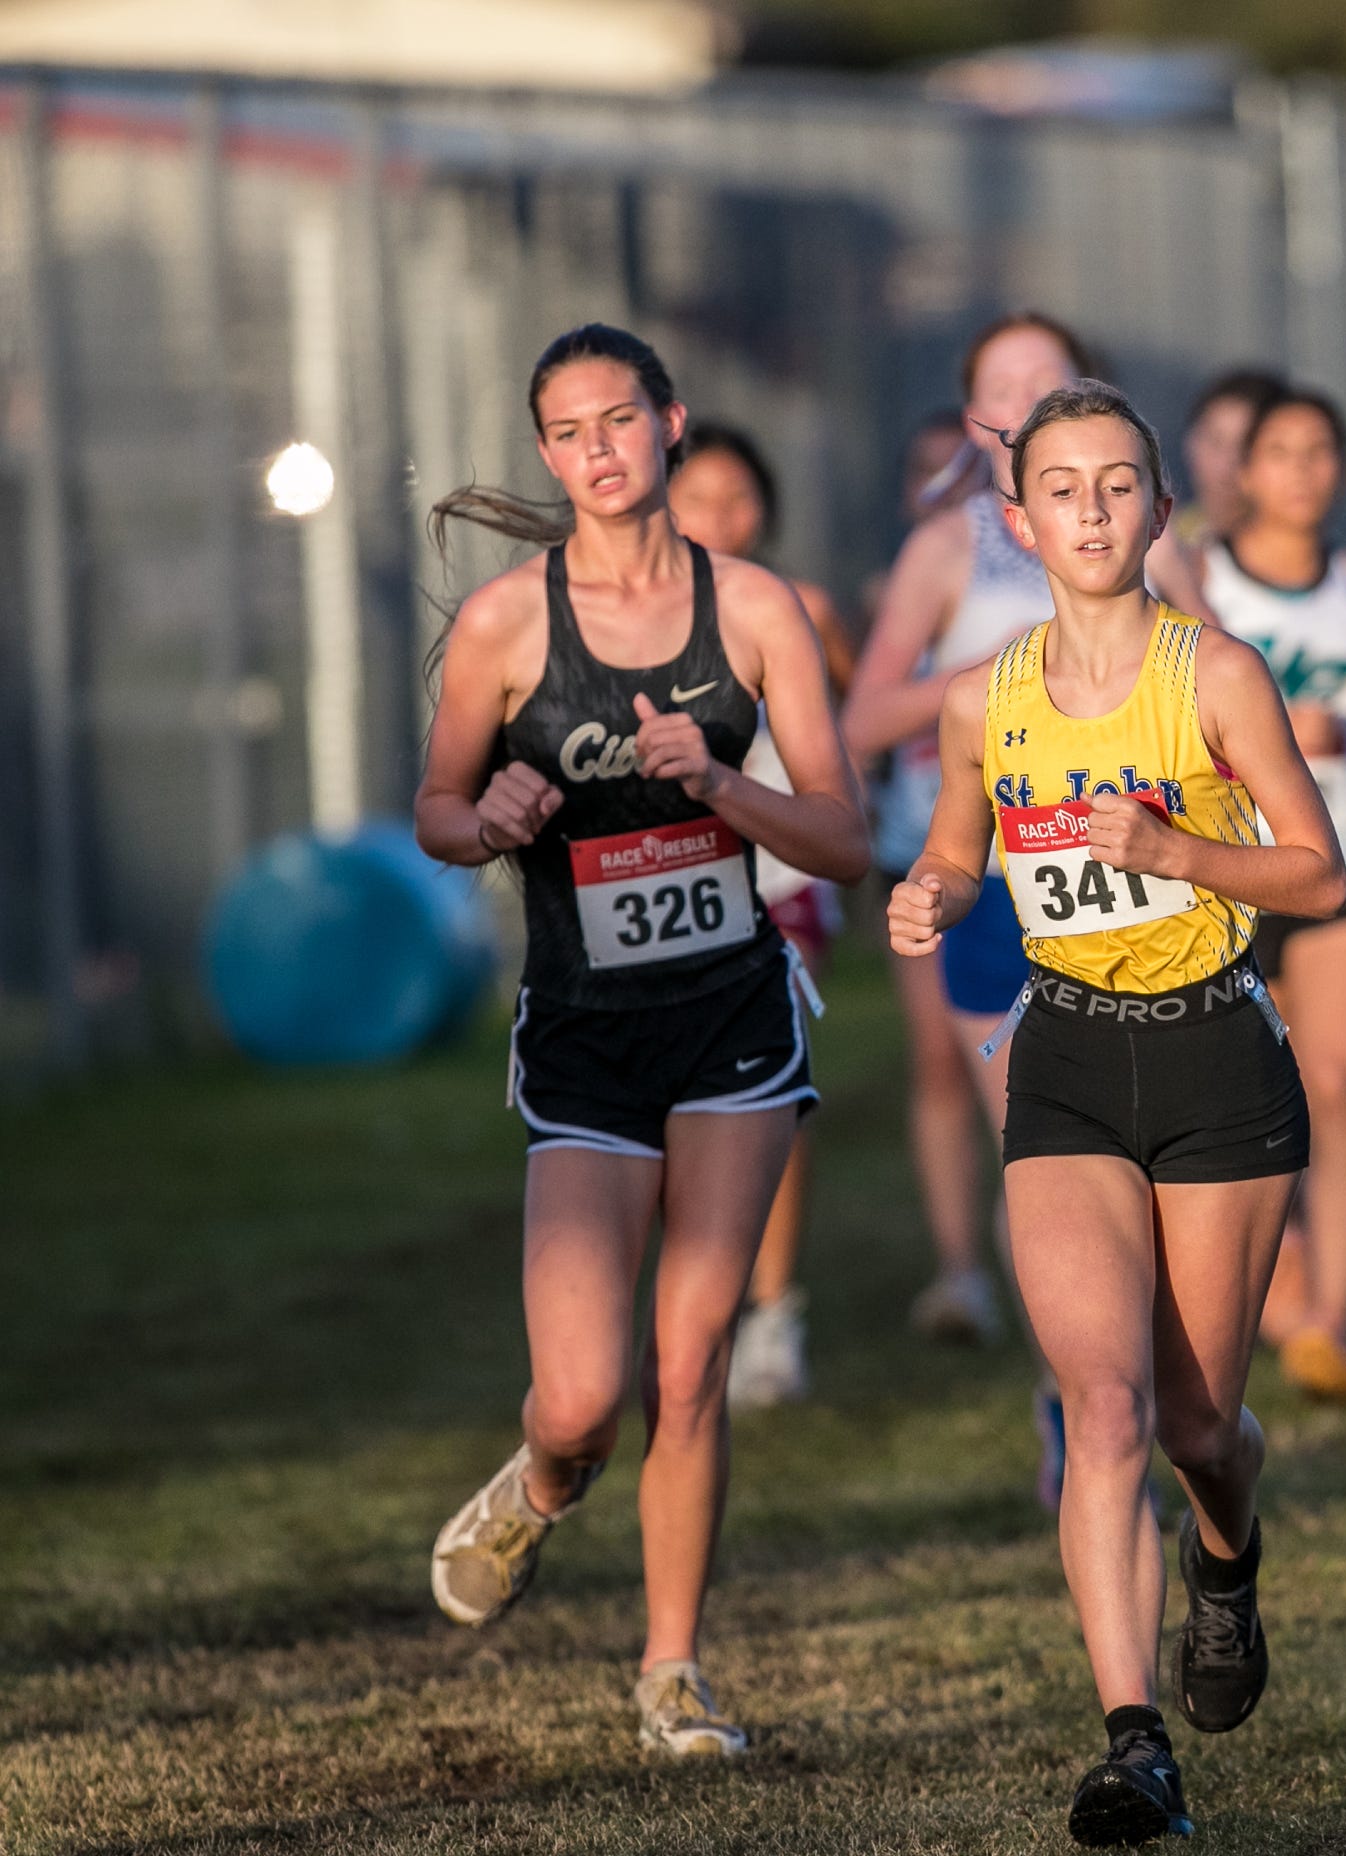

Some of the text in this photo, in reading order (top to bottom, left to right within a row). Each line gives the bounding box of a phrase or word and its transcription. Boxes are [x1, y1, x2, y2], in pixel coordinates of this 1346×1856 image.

[600, 847, 643, 870] RACE
[663, 832, 718, 857] RESULT
[1018, 821, 1059, 839] RACE
[612, 876, 724, 948] 326
[1035, 860, 1150, 921] 341
[1033, 971, 1084, 1011] KE
[1086, 994, 1188, 1023] PRO
